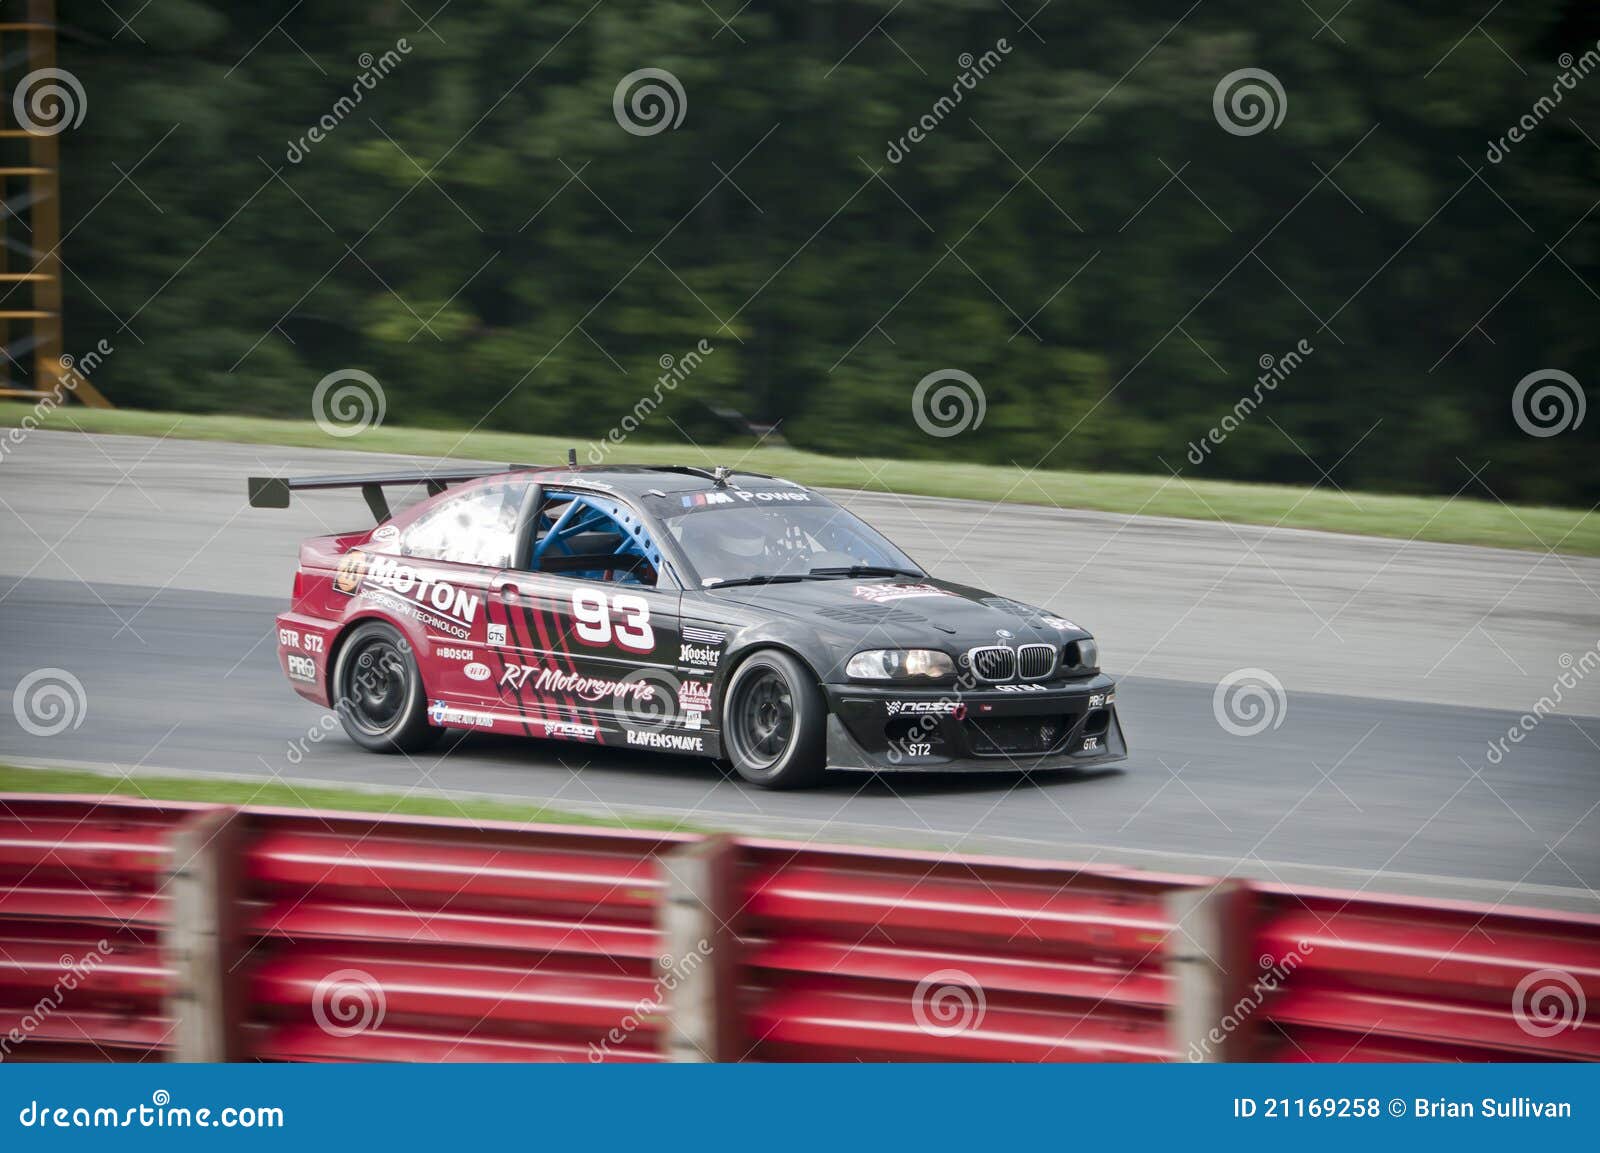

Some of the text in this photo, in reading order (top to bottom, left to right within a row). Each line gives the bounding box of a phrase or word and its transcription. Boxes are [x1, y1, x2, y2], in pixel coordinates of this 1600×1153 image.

[734, 491, 811, 502] Power
[366, 555, 479, 623] MOTON
[411, 609, 471, 641] TECHNOLOGY
[571, 587, 656, 651] 93
[279, 629, 324, 653] GTR ST2
[488, 631, 504, 642] GTS
[443, 648, 474, 661] BOSCH
[679, 643, 720, 662] Hoosier
[500, 663, 656, 701] RT Motorsports
[627, 730, 704, 752] RAVENSWAVE
[908, 743, 931, 757] ST2
[1083, 737, 1098, 750] GTR
